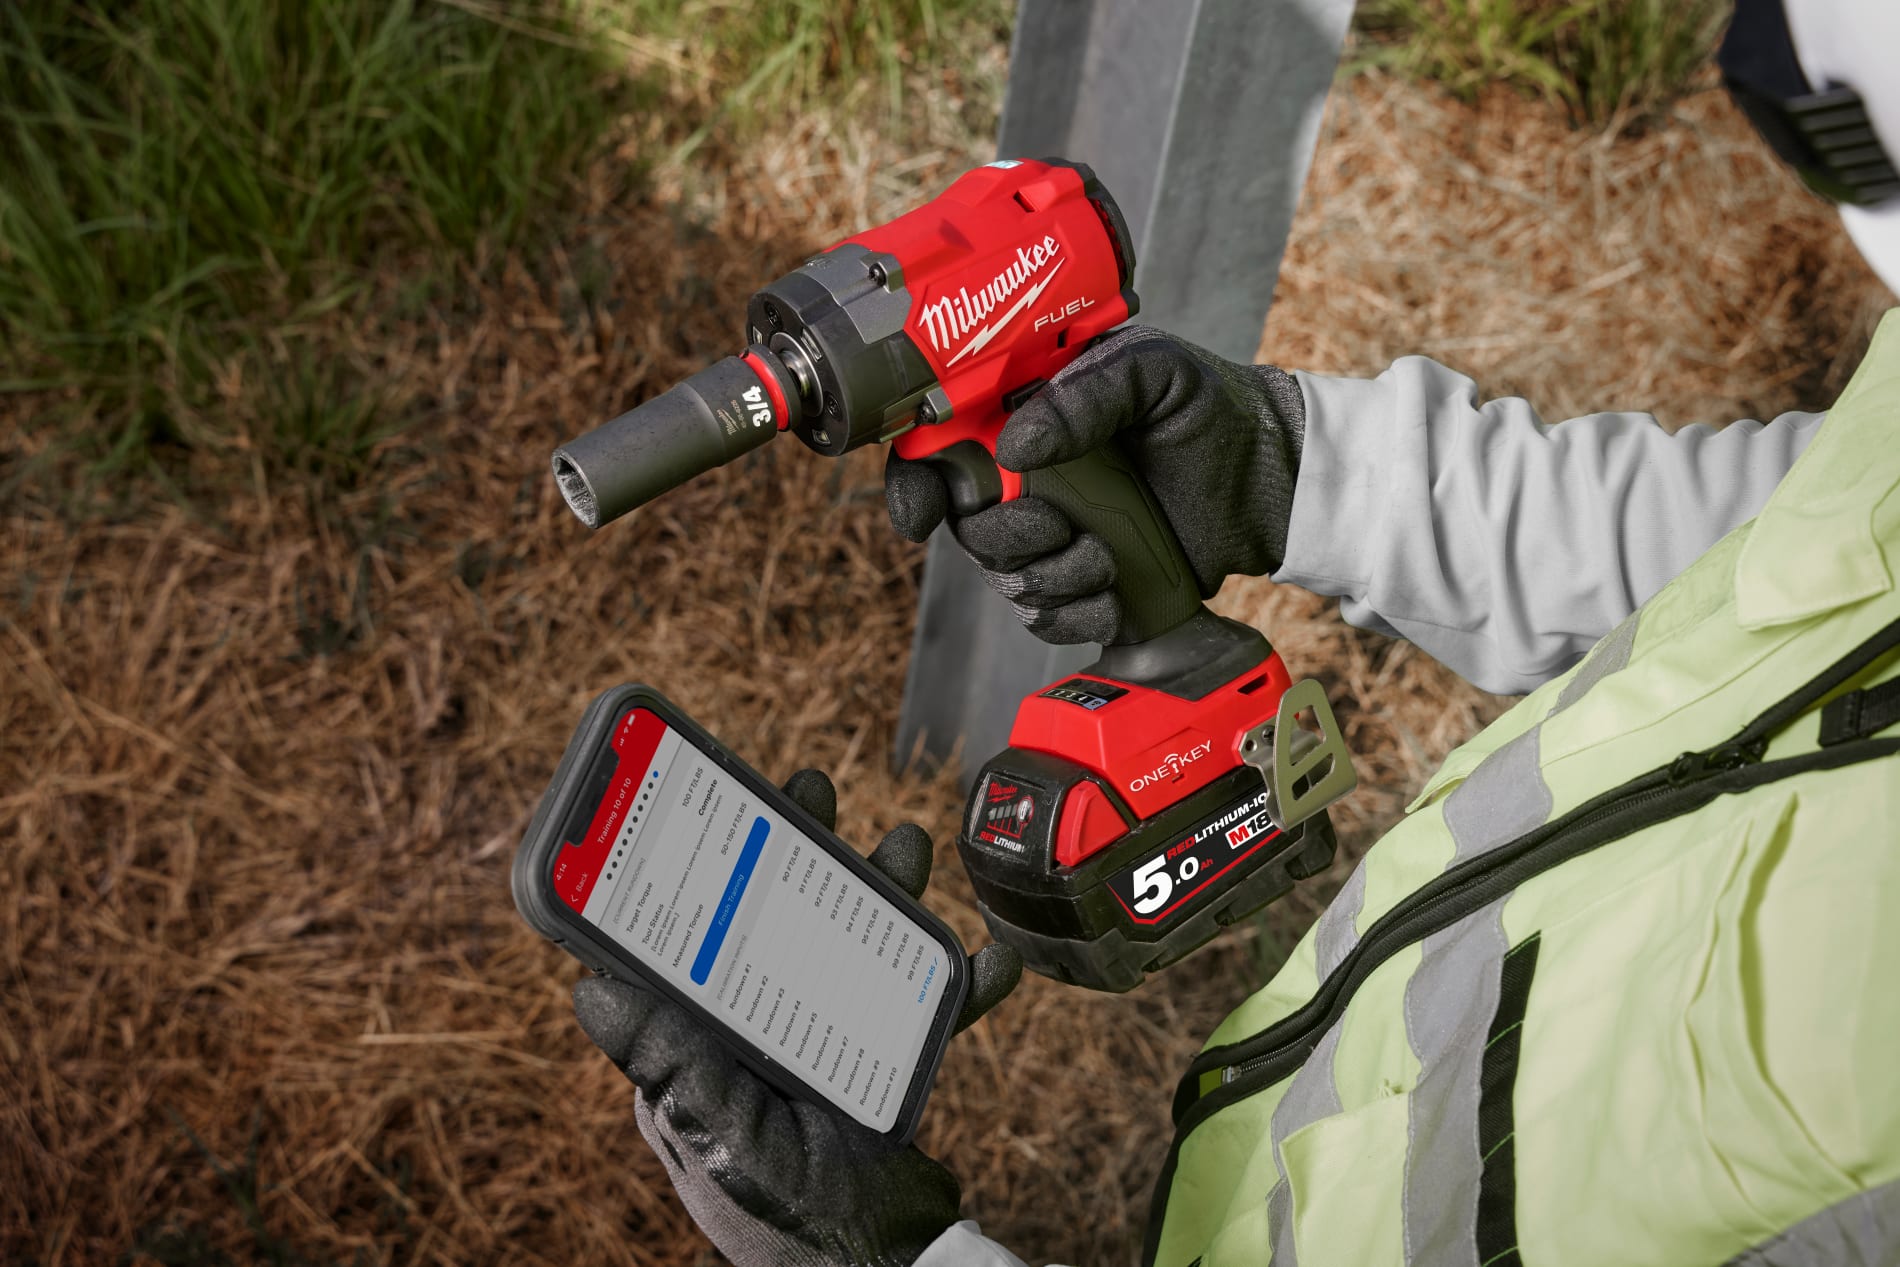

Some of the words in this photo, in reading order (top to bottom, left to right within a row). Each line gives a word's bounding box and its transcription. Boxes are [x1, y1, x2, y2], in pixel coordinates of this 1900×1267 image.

[919, 235, 1060, 353] Milwaukee
[1034, 297, 1095, 332] FUEL
[742, 385, 771, 427] 3/4
[681, 793, 691, 807] 100
[688, 767, 703, 793] FT/LBS
[698, 779, 717, 815] Complete
[597, 811, 617, 843] Training
[613, 799, 621, 809] 10
[619, 788, 626, 799] of
[623, 777, 631, 787] 10
[732, 802, 746, 828] FT/LBS
[1166, 792, 1268, 860] REDLITHIUM-IO
[1228, 811, 1273, 846] M18
[556, 863, 566, 880] 4:14
[575, 872, 587, 891] Back
[782, 871, 789, 882] 90
[786, 845, 800, 871] FT/LBS
[798, 883, 805, 893] 91
[802, 858, 816, 884] FT/LBS
[626, 908, 640, 932] Target
[637, 882, 652, 907] Torque
[718, 903, 730, 925] Finish
[727, 873, 744, 901] Training
[814, 896, 821, 907] 92
[818, 871, 832, 896] FT/LBS
[830, 908, 837, 920] 93
[834, 883, 848, 909] FT/LBS
[641, 927, 652, 944] Tool
[649, 903, 663, 928] Status
[845, 921, 853, 932] 94
[850, 895, 863, 921] FT/LBS
[861, 934, 868, 944] 95
[865, 908, 878, 933] FT/LBS
[881, 920, 894, 945] FT/LBS
[672, 929, 691, 967] Measured
[688, 903, 703, 928] Torque
[896, 932, 909, 957] FT/LBS
[911, 944, 923, 969] FT/LBS
[728, 975, 747, 1009] Rundown
[744, 963, 751, 973] #1
[745, 987, 763, 1022] Rundown
[761, 975, 768, 986] #2
[762, 999, 780, 1034] Rundown
[777, 987, 784, 998] #3
[779, 1012, 796, 1046] Rundown
[794, 1000, 800, 1010] #4
[795, 1024, 812, 1058] Rundown
[810, 1011, 817, 1023] #5
[811, 1036, 828, 1070] Rundown
[826, 1024, 833, 1034] #6
[827, 1048, 844, 1082] Rundown
[842, 1035, 848, 1046] #7
[843, 1060, 860, 1094] Rundown
[857, 1048, 864, 1058] #8
[859, 1071, 875, 1105] Rundown
[873, 1059, 879, 1070] #9
[874, 1083, 891, 1117] Rundown
[888, 1066, 896, 1081] #10
